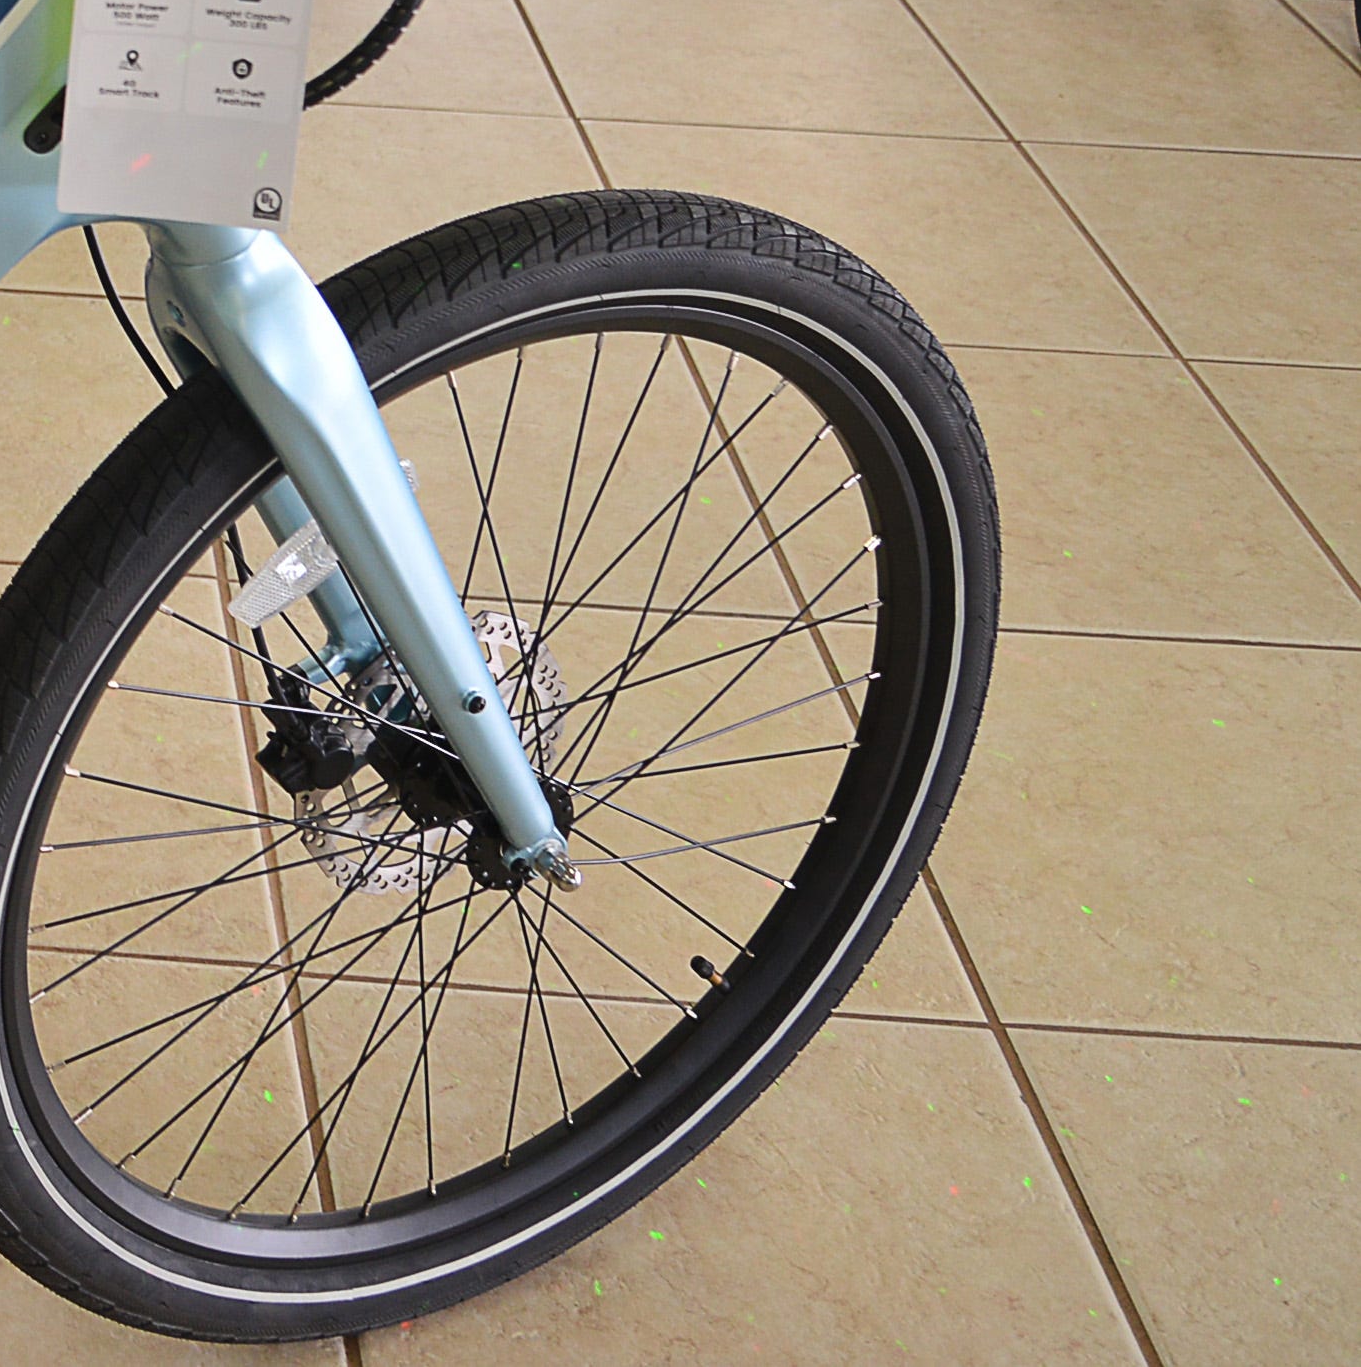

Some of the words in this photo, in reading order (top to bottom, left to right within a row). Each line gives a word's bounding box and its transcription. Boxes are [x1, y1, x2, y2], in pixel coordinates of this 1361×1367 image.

[106, 1, 135, 10] Motor
[139, 3, 169, 12] Power
[206, 8, 242, 20] Weight
[246, 11, 291, 25] Capacity
[99, 87, 129, 96] Smart
[132, 88, 160, 99] Track
[215, 87, 266, 98] Anti-Theft
[217, 97, 262, 108] Features
